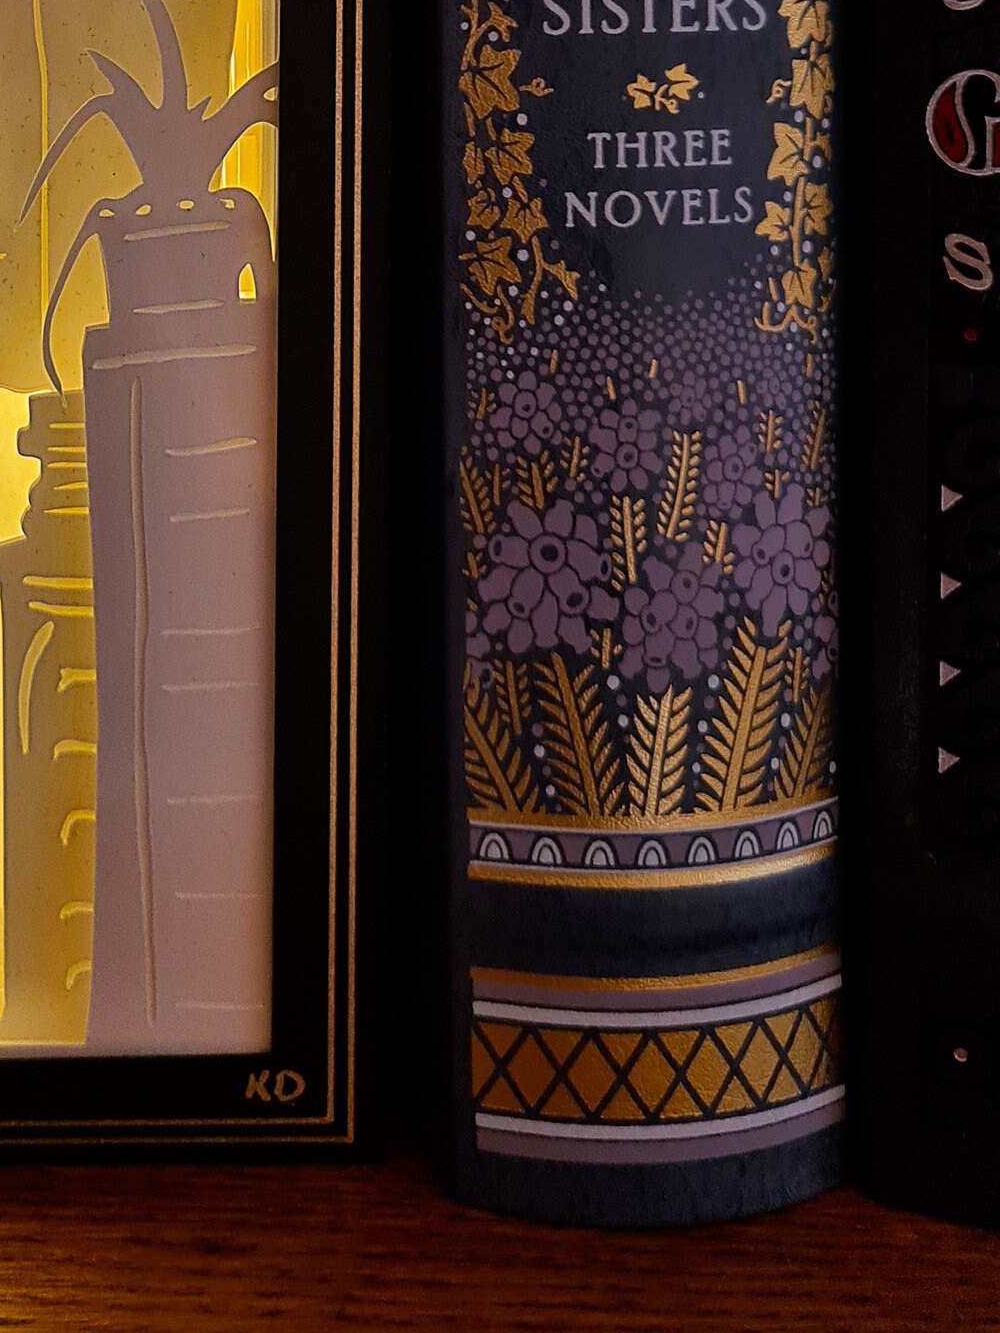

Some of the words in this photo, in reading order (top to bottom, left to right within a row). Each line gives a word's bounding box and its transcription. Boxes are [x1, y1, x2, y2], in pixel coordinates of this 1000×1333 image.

[586, 128, 733, 169] THREE
[564, 186, 754, 228] NOVELS
[244, 1069, 307, 1102] KD
